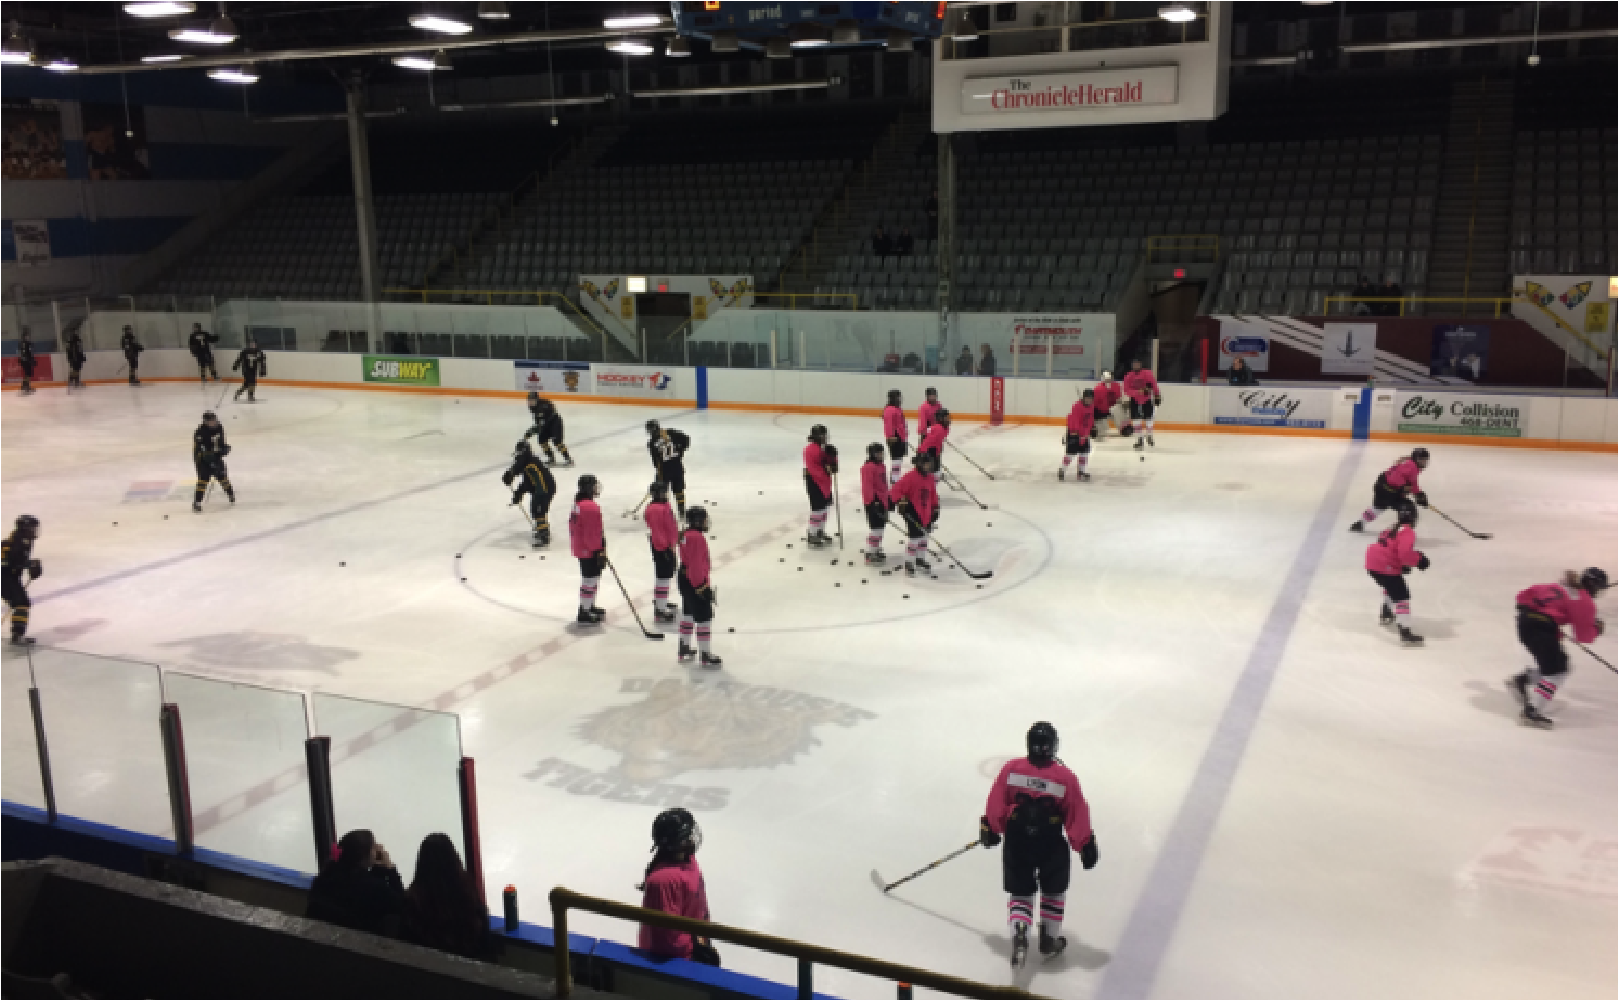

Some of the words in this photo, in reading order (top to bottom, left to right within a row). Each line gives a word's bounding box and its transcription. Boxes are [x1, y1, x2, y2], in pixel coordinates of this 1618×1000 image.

[991, 79, 1143, 109] ChronicleHerald
[1009, 78, 1032, 90] The
[370, 360, 434, 380] SUBWAY
[1239, 390, 1301, 419] City
[1401, 395, 1444, 421] City
[1449, 400, 1520, 419] Collision
[618, 677, 880, 728] DAOUSIE
[520, 756, 732, 812] TIGERS
